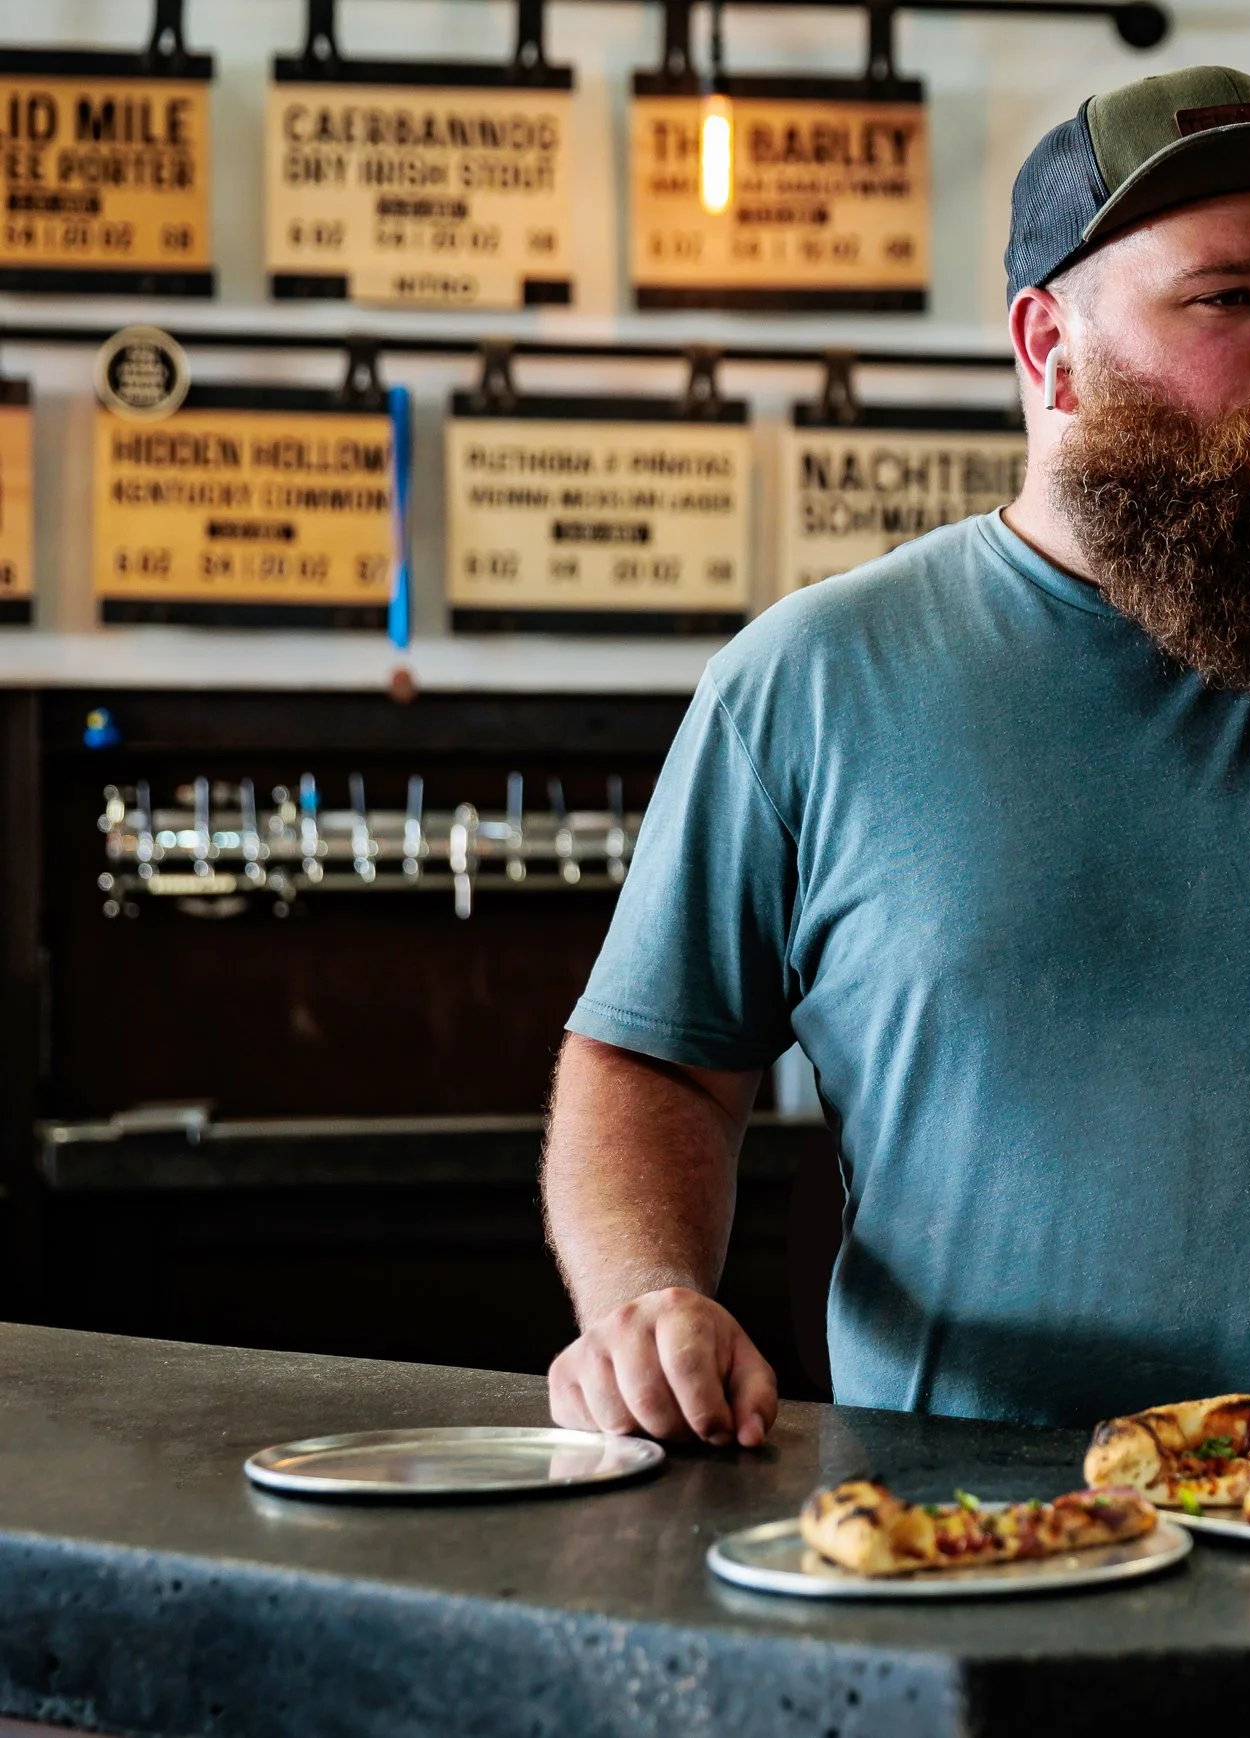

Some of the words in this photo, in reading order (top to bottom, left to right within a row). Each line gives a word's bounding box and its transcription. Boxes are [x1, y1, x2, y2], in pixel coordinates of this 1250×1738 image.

[0, 93, 58, 141] ID
[75, 96, 192, 144] MILE
[747, 119, 909, 168] BARLEY
[0, 150, 44, 185] EE
[58, 152, 193, 190] PORTER
[285, 151, 346, 186] DRY
[359, 154, 447, 189] IRISH
[459, 157, 556, 192] STOUT
[393, 275, 476, 299] NITRO
[111, 432, 242, 471] HIDDEN
[251, 436, 388, 475] HOLLOW
[466, 447, 595, 475] PLETHORA
[111, 478, 251, 510] KENTUCKY
[261, 483, 389, 514] COMMON
[466, 486, 553, 511] VIENNA
